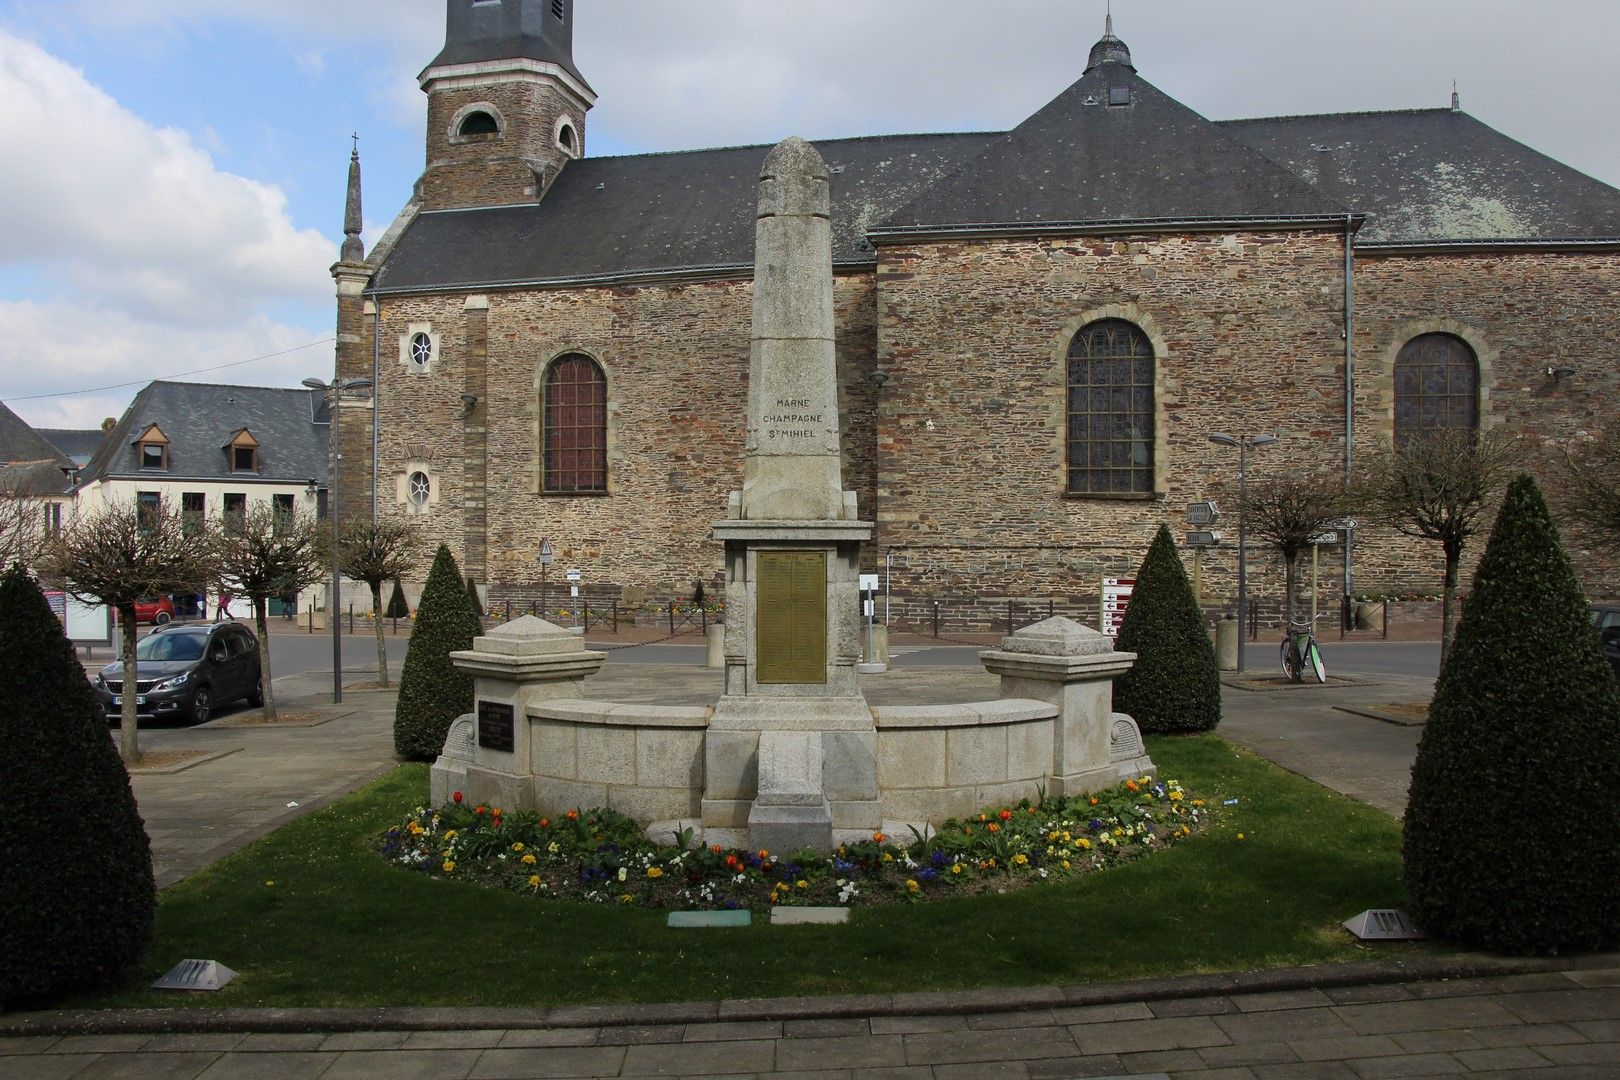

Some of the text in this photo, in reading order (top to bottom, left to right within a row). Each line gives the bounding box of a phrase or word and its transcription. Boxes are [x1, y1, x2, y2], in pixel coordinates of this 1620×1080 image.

[776, 399, 810, 408] MARNE
[762, 414, 823, 423] CHAMPAGNE
[781, 429, 816, 438] MIHIEL
